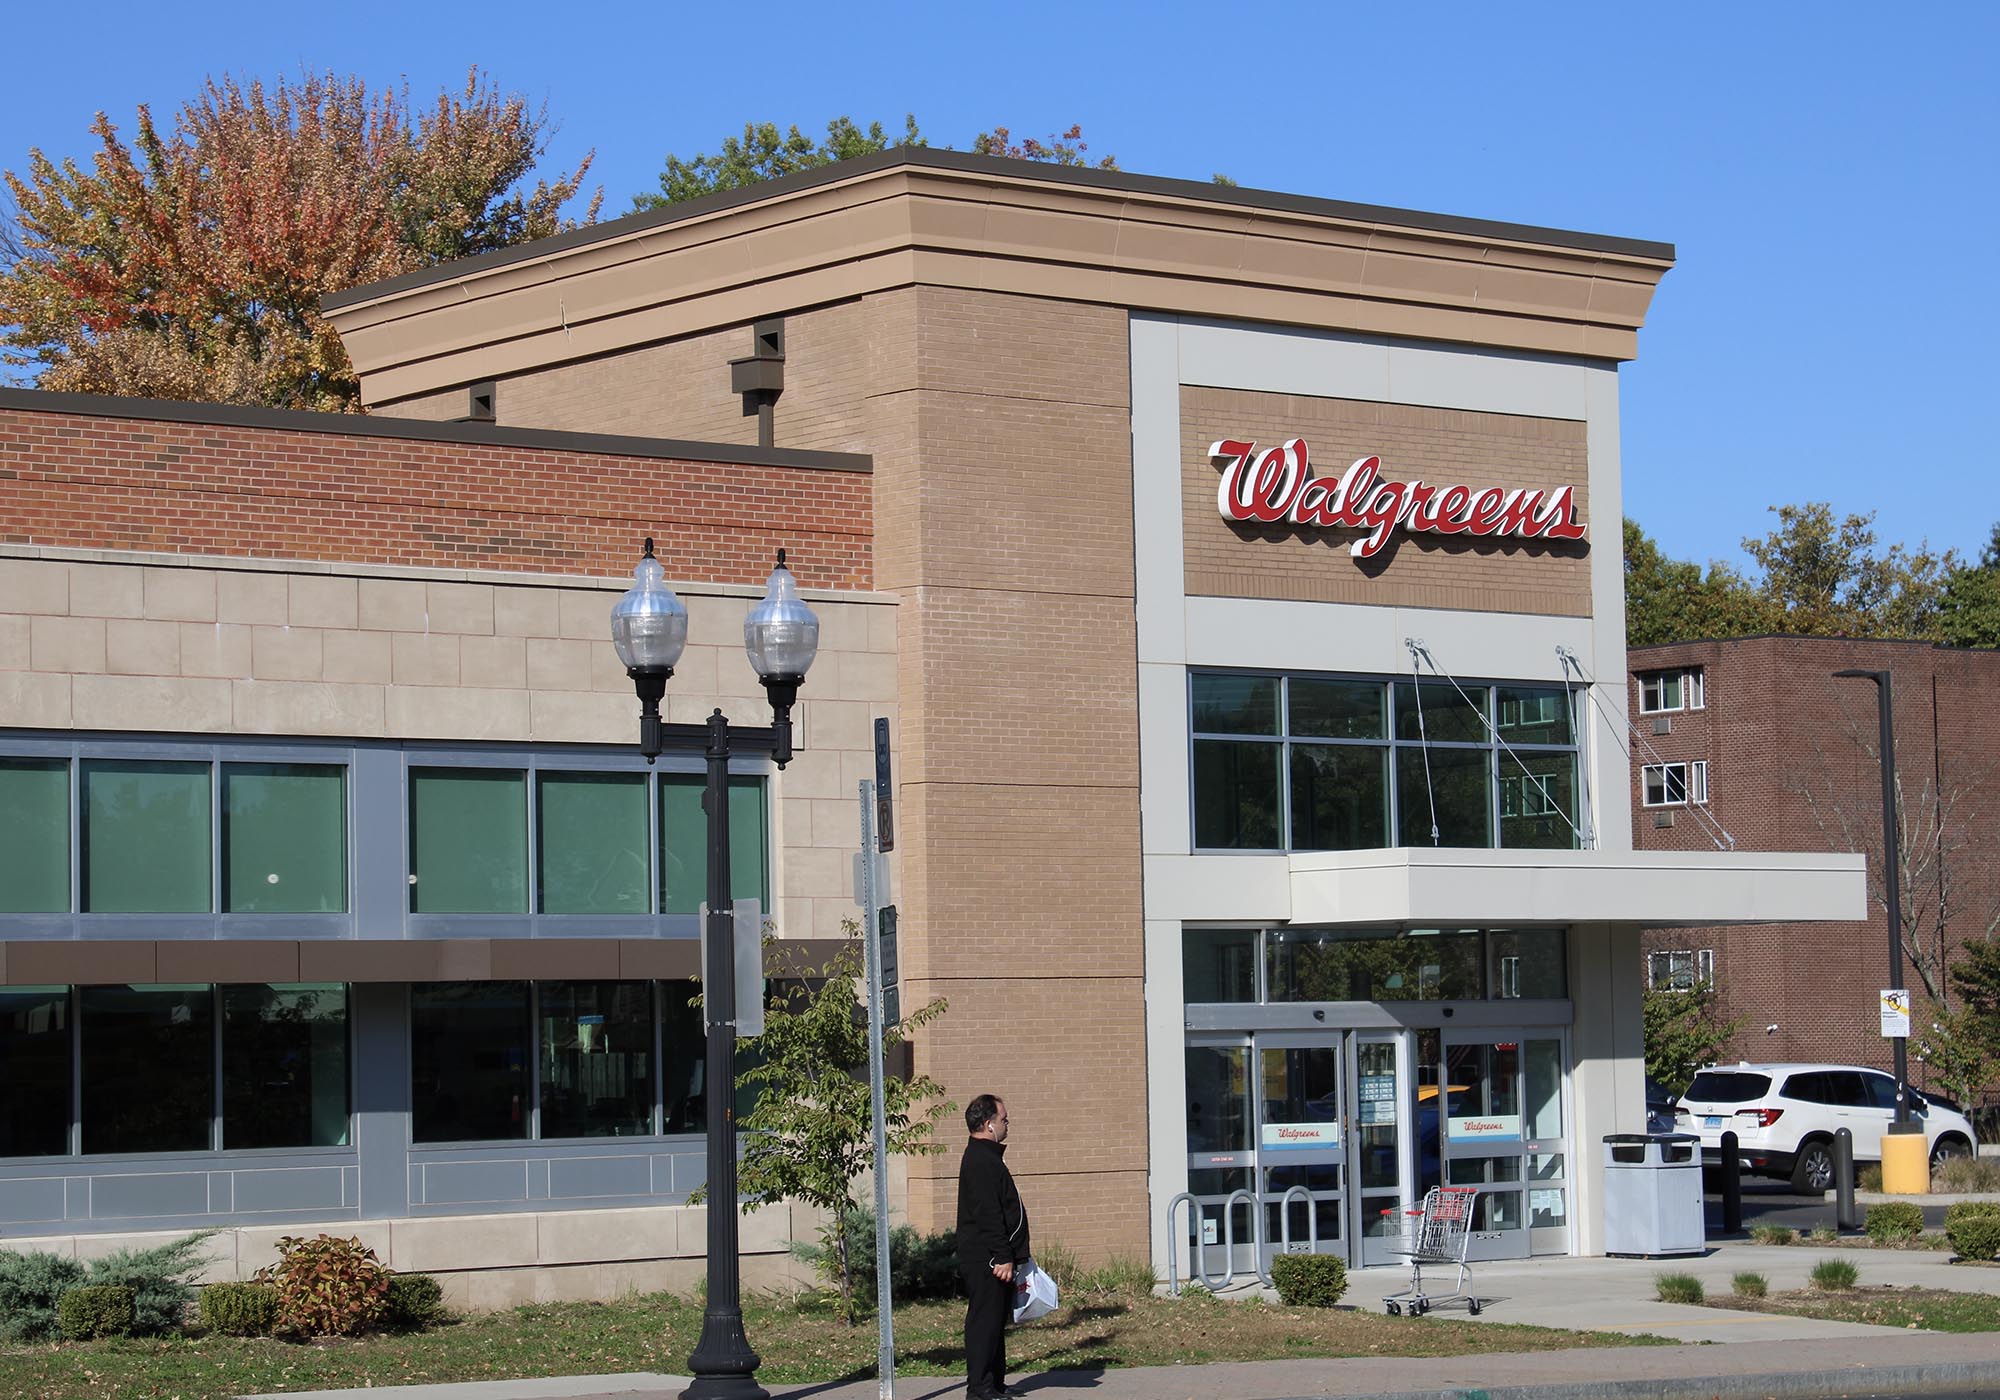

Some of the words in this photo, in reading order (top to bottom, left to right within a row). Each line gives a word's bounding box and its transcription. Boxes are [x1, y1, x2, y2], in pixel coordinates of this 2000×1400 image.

[1208, 437, 1588, 558] Walgreens
[1464, 1121, 1504, 1133] Walgreens
[1278, 1128, 1320, 1140] Walgreens
